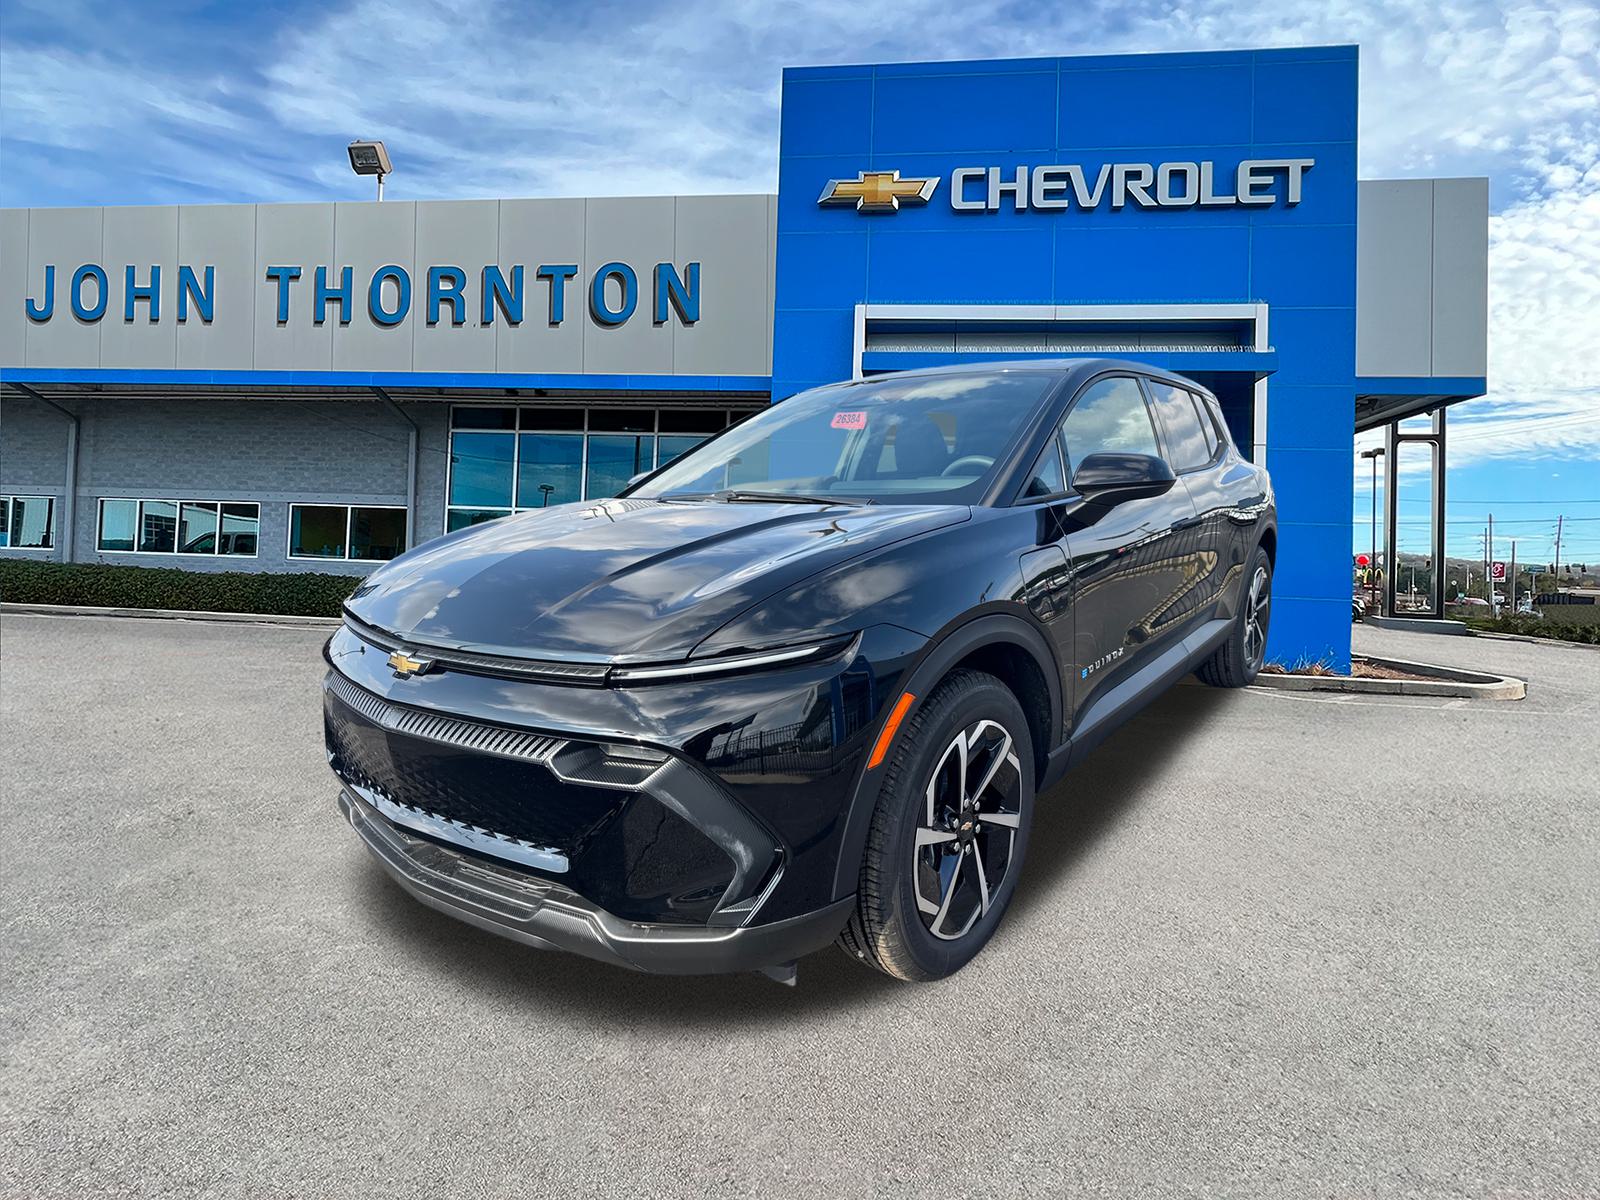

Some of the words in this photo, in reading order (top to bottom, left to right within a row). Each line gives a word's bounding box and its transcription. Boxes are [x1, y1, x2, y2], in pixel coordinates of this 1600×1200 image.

[951, 158, 1316, 212] CHEVROLET
[25, 263, 215, 324] JOHN
[266, 261, 702, 327] THORNTON
[835, 413, 861, 424] 26384
[1081, 647, 1124, 679] EQUINOX
